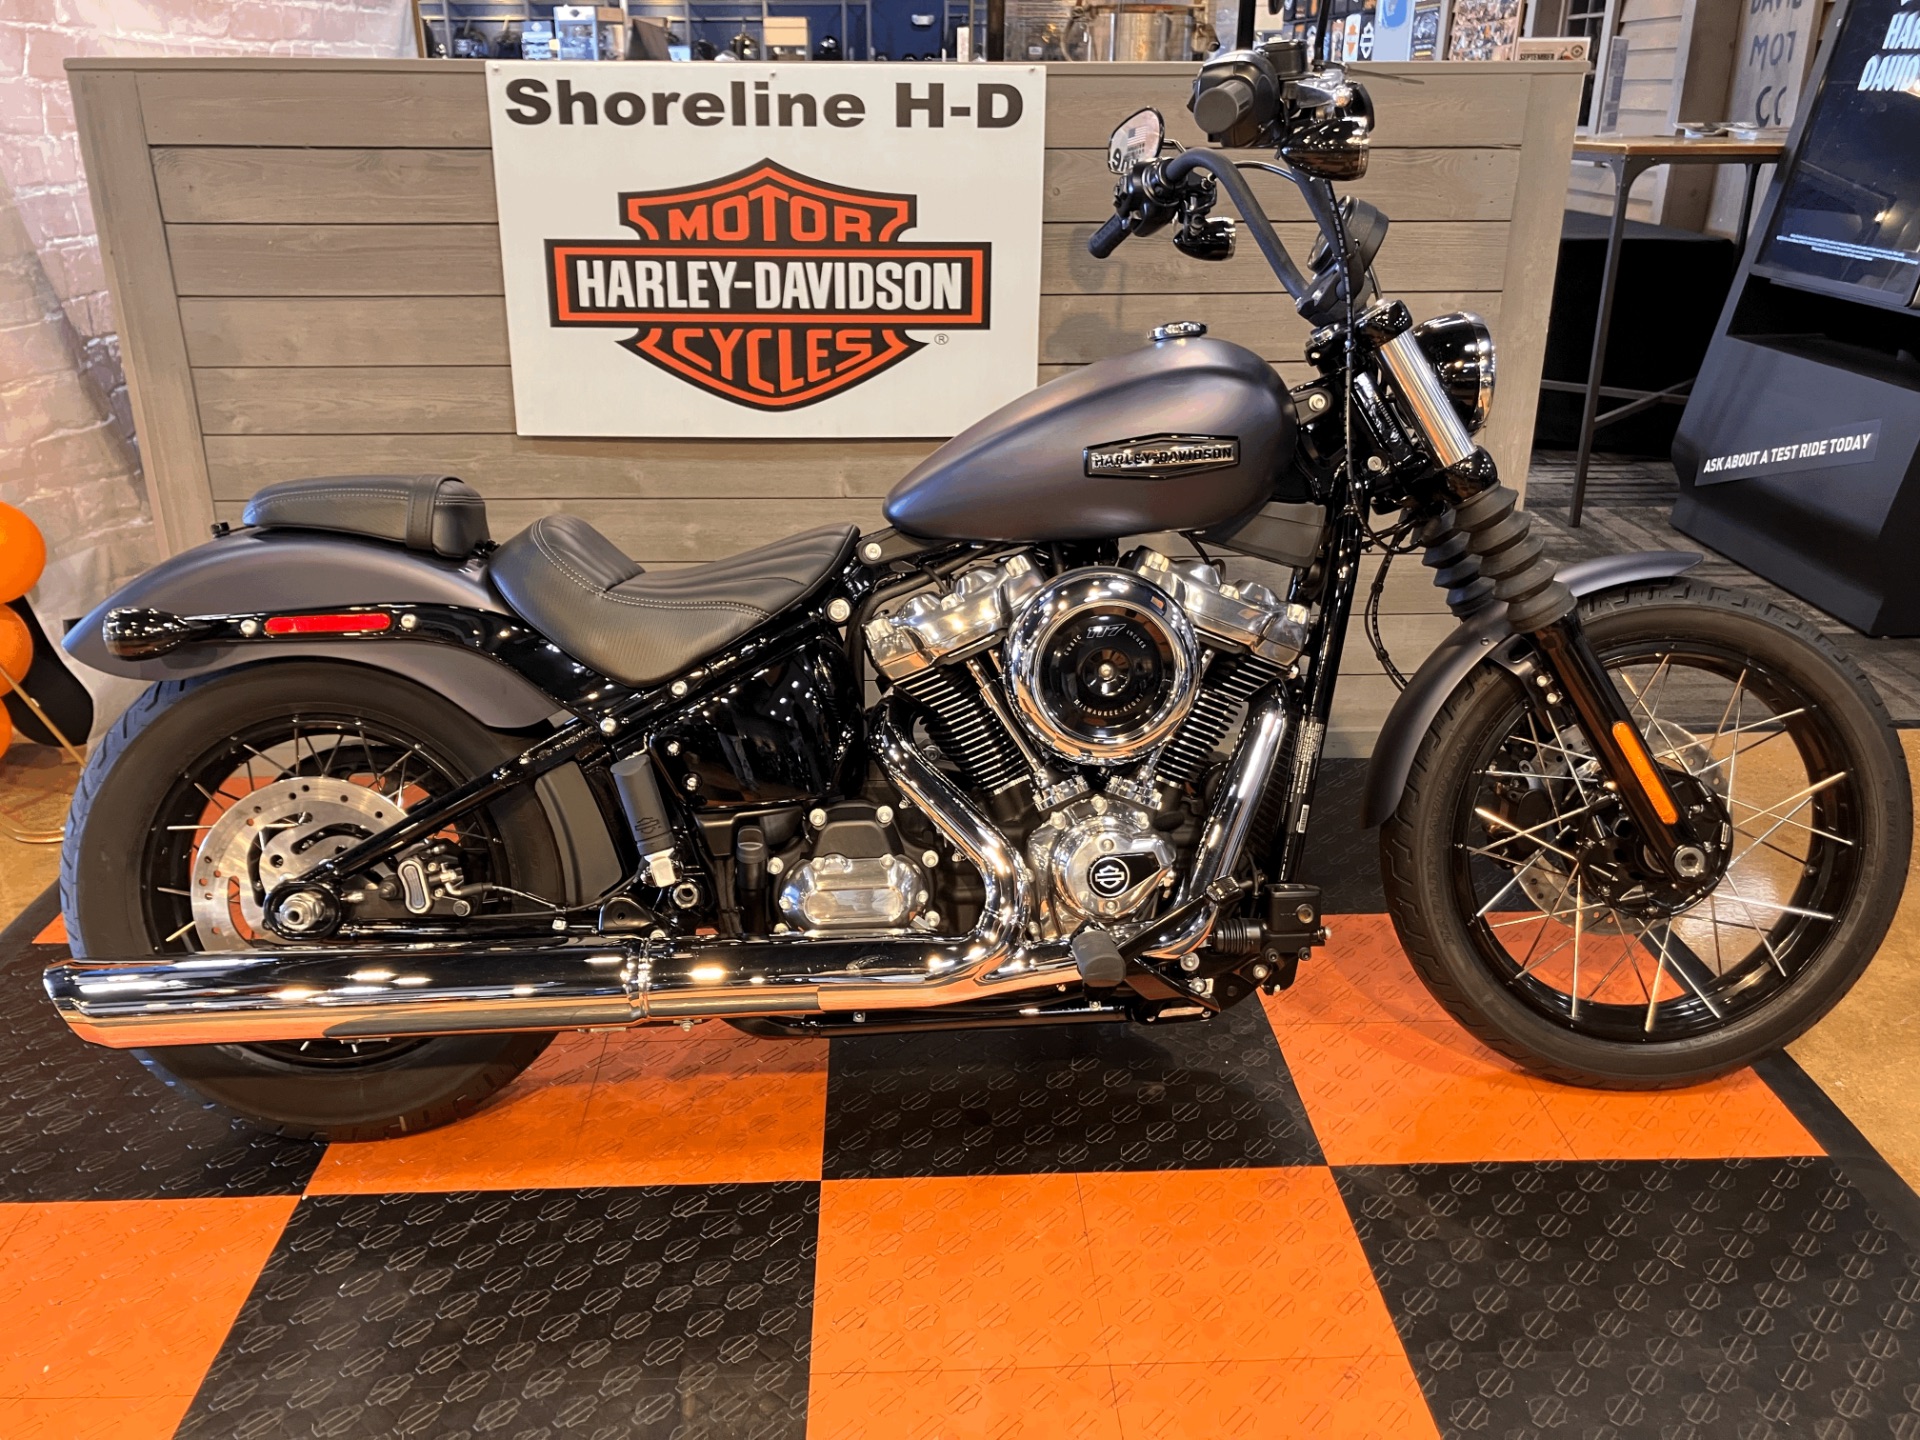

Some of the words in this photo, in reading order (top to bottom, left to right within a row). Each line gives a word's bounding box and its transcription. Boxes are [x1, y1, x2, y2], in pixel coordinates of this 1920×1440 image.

[1519, 53, 1555, 61] SEPTEMBER
[505, 78, 866, 127] Shoreline
[895, 82, 1022, 128] H-D
[668, 184, 872, 243] MOTOR
[576, 259, 963, 311] HARLEY-DAVIDSON
[672, 328, 873, 394] CYCLES
[1092, 444, 1234, 469] HARLEY-DAVIDSON
[1704, 457, 1724, 473] ASK
[1724, 451, 1759, 470] ABOUT
[1758, 450, 1769, 465] A
[1771, 444, 1799, 463] TEST
[1799, 440, 1828, 460] RIDE
[1830, 434, 1872, 453] TODAY
[1086, 623, 1127, 639] 117
[1126, 630, 1147, 649] INCHES
